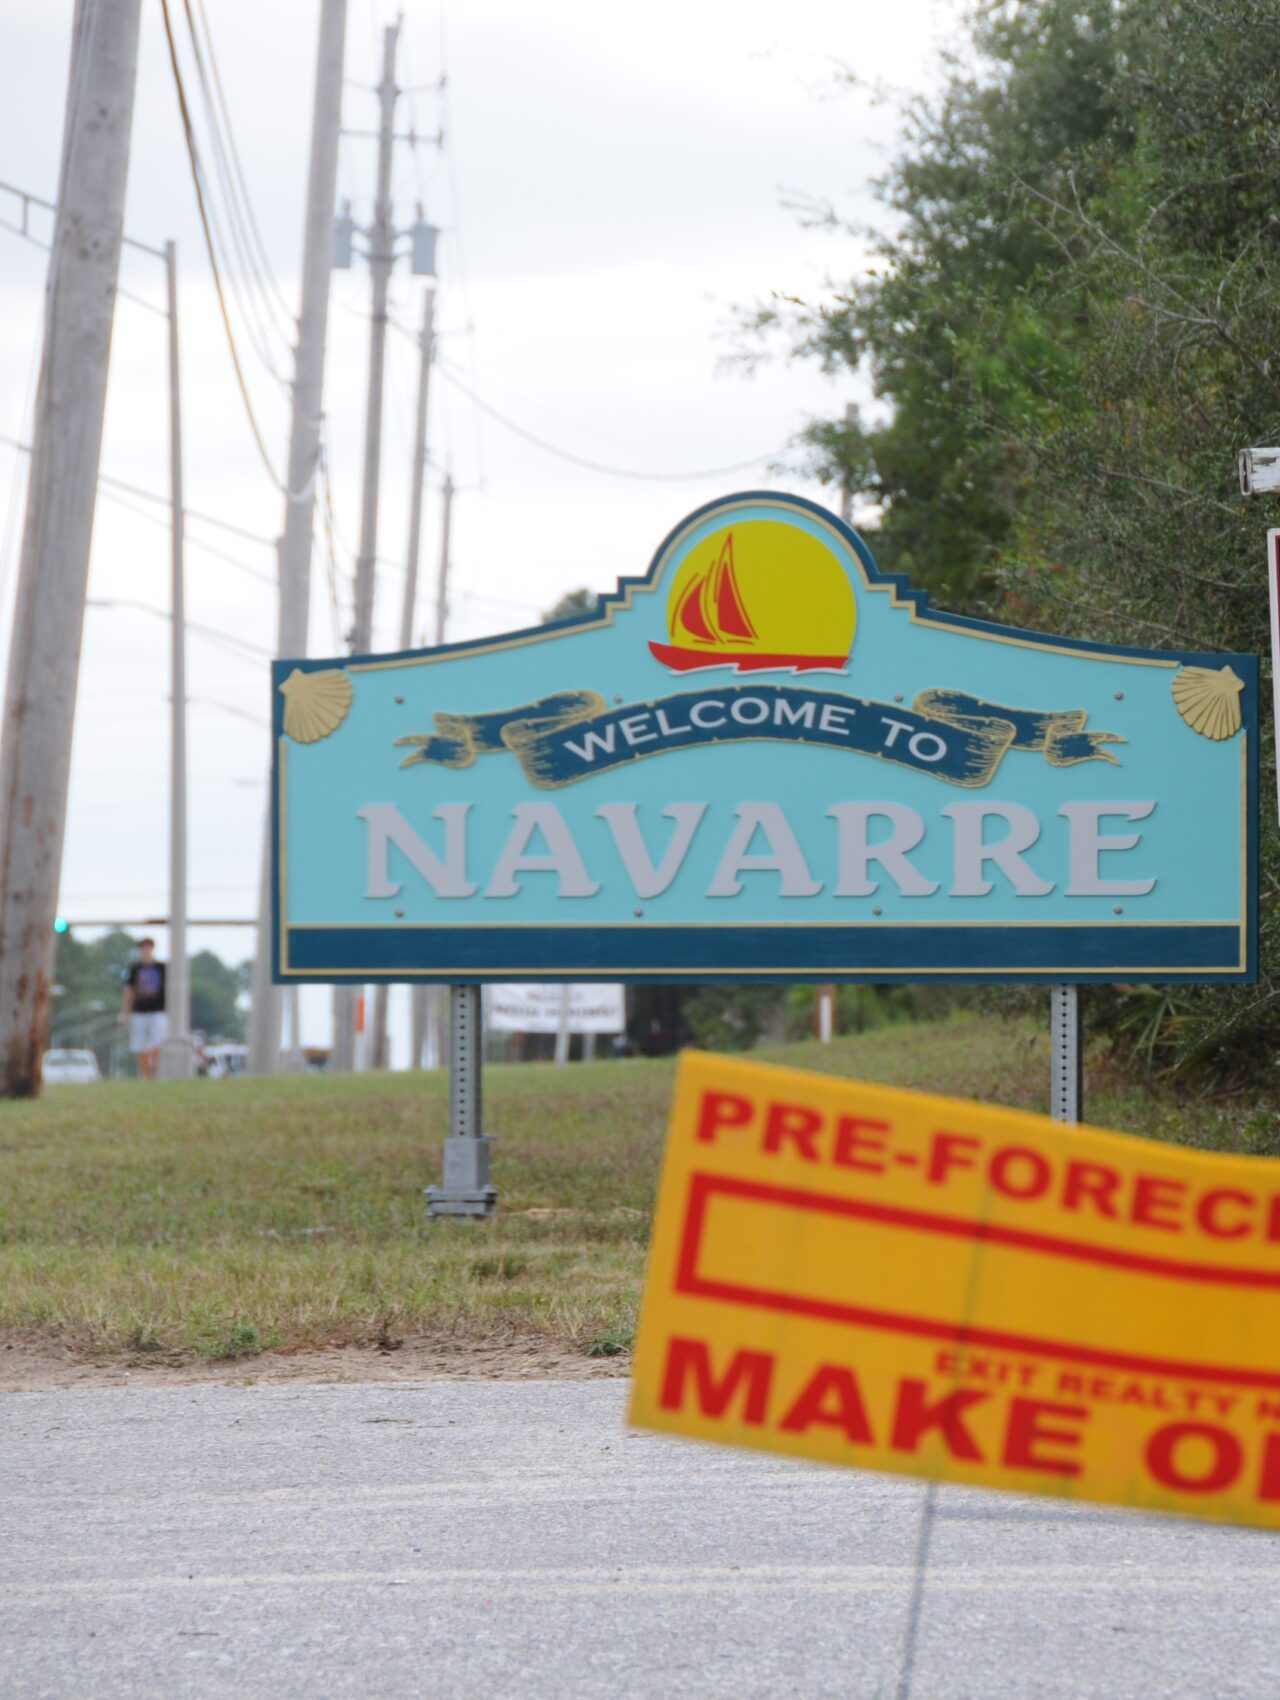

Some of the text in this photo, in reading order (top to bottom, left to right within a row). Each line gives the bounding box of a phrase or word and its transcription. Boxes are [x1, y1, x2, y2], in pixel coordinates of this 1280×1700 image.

[563, 695, 948, 763] WELCOME TO
[355, 800, 1160, 900] NAVARRE
[655, 1335, 1094, 1480] MAKE
[934, 1350, 1039, 1389] EXIT
[1055, 1369, 1241, 1420] REALTY
